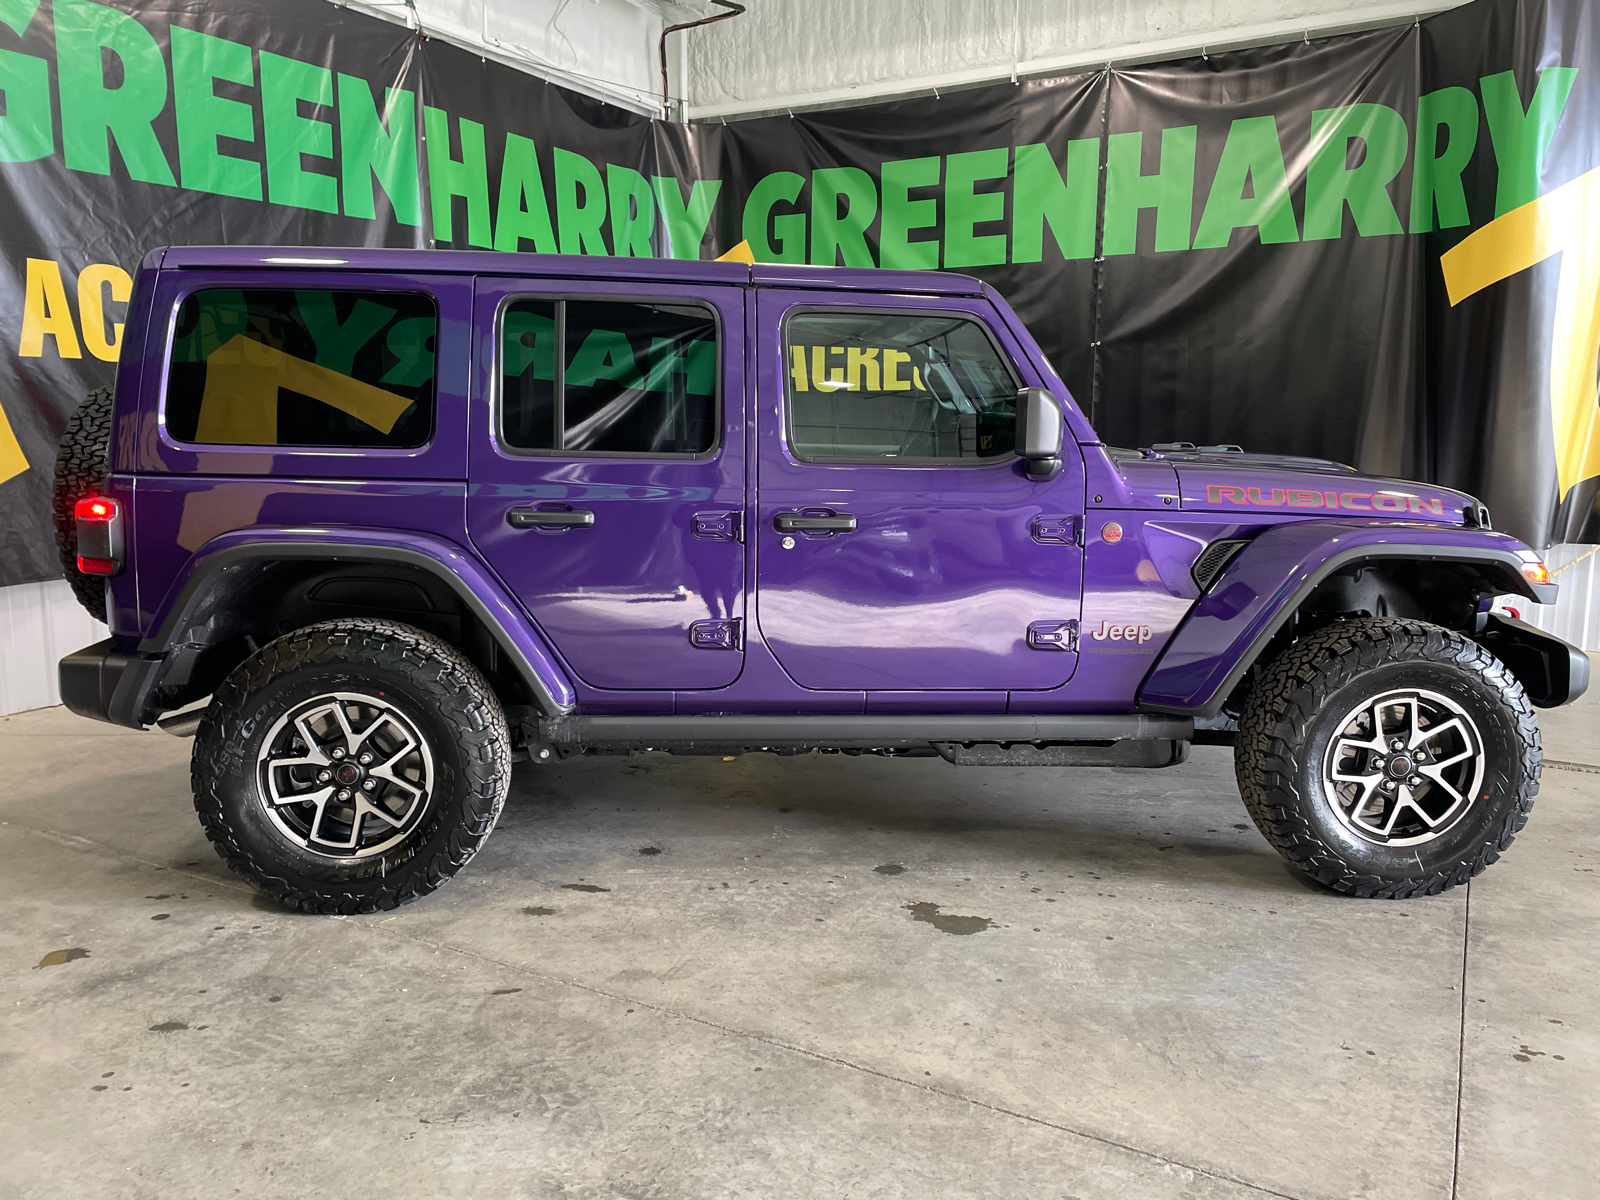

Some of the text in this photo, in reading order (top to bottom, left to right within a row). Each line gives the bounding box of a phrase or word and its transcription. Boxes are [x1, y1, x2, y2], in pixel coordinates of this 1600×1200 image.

[424, 105, 722, 260] HARRY
[742, 139, 1101, 270] GREEN
[1102, 67, 1579, 256] HARRY
[1206, 484, 1444, 516] RUBICON
[1091, 619, 1154, 645] Jeep
